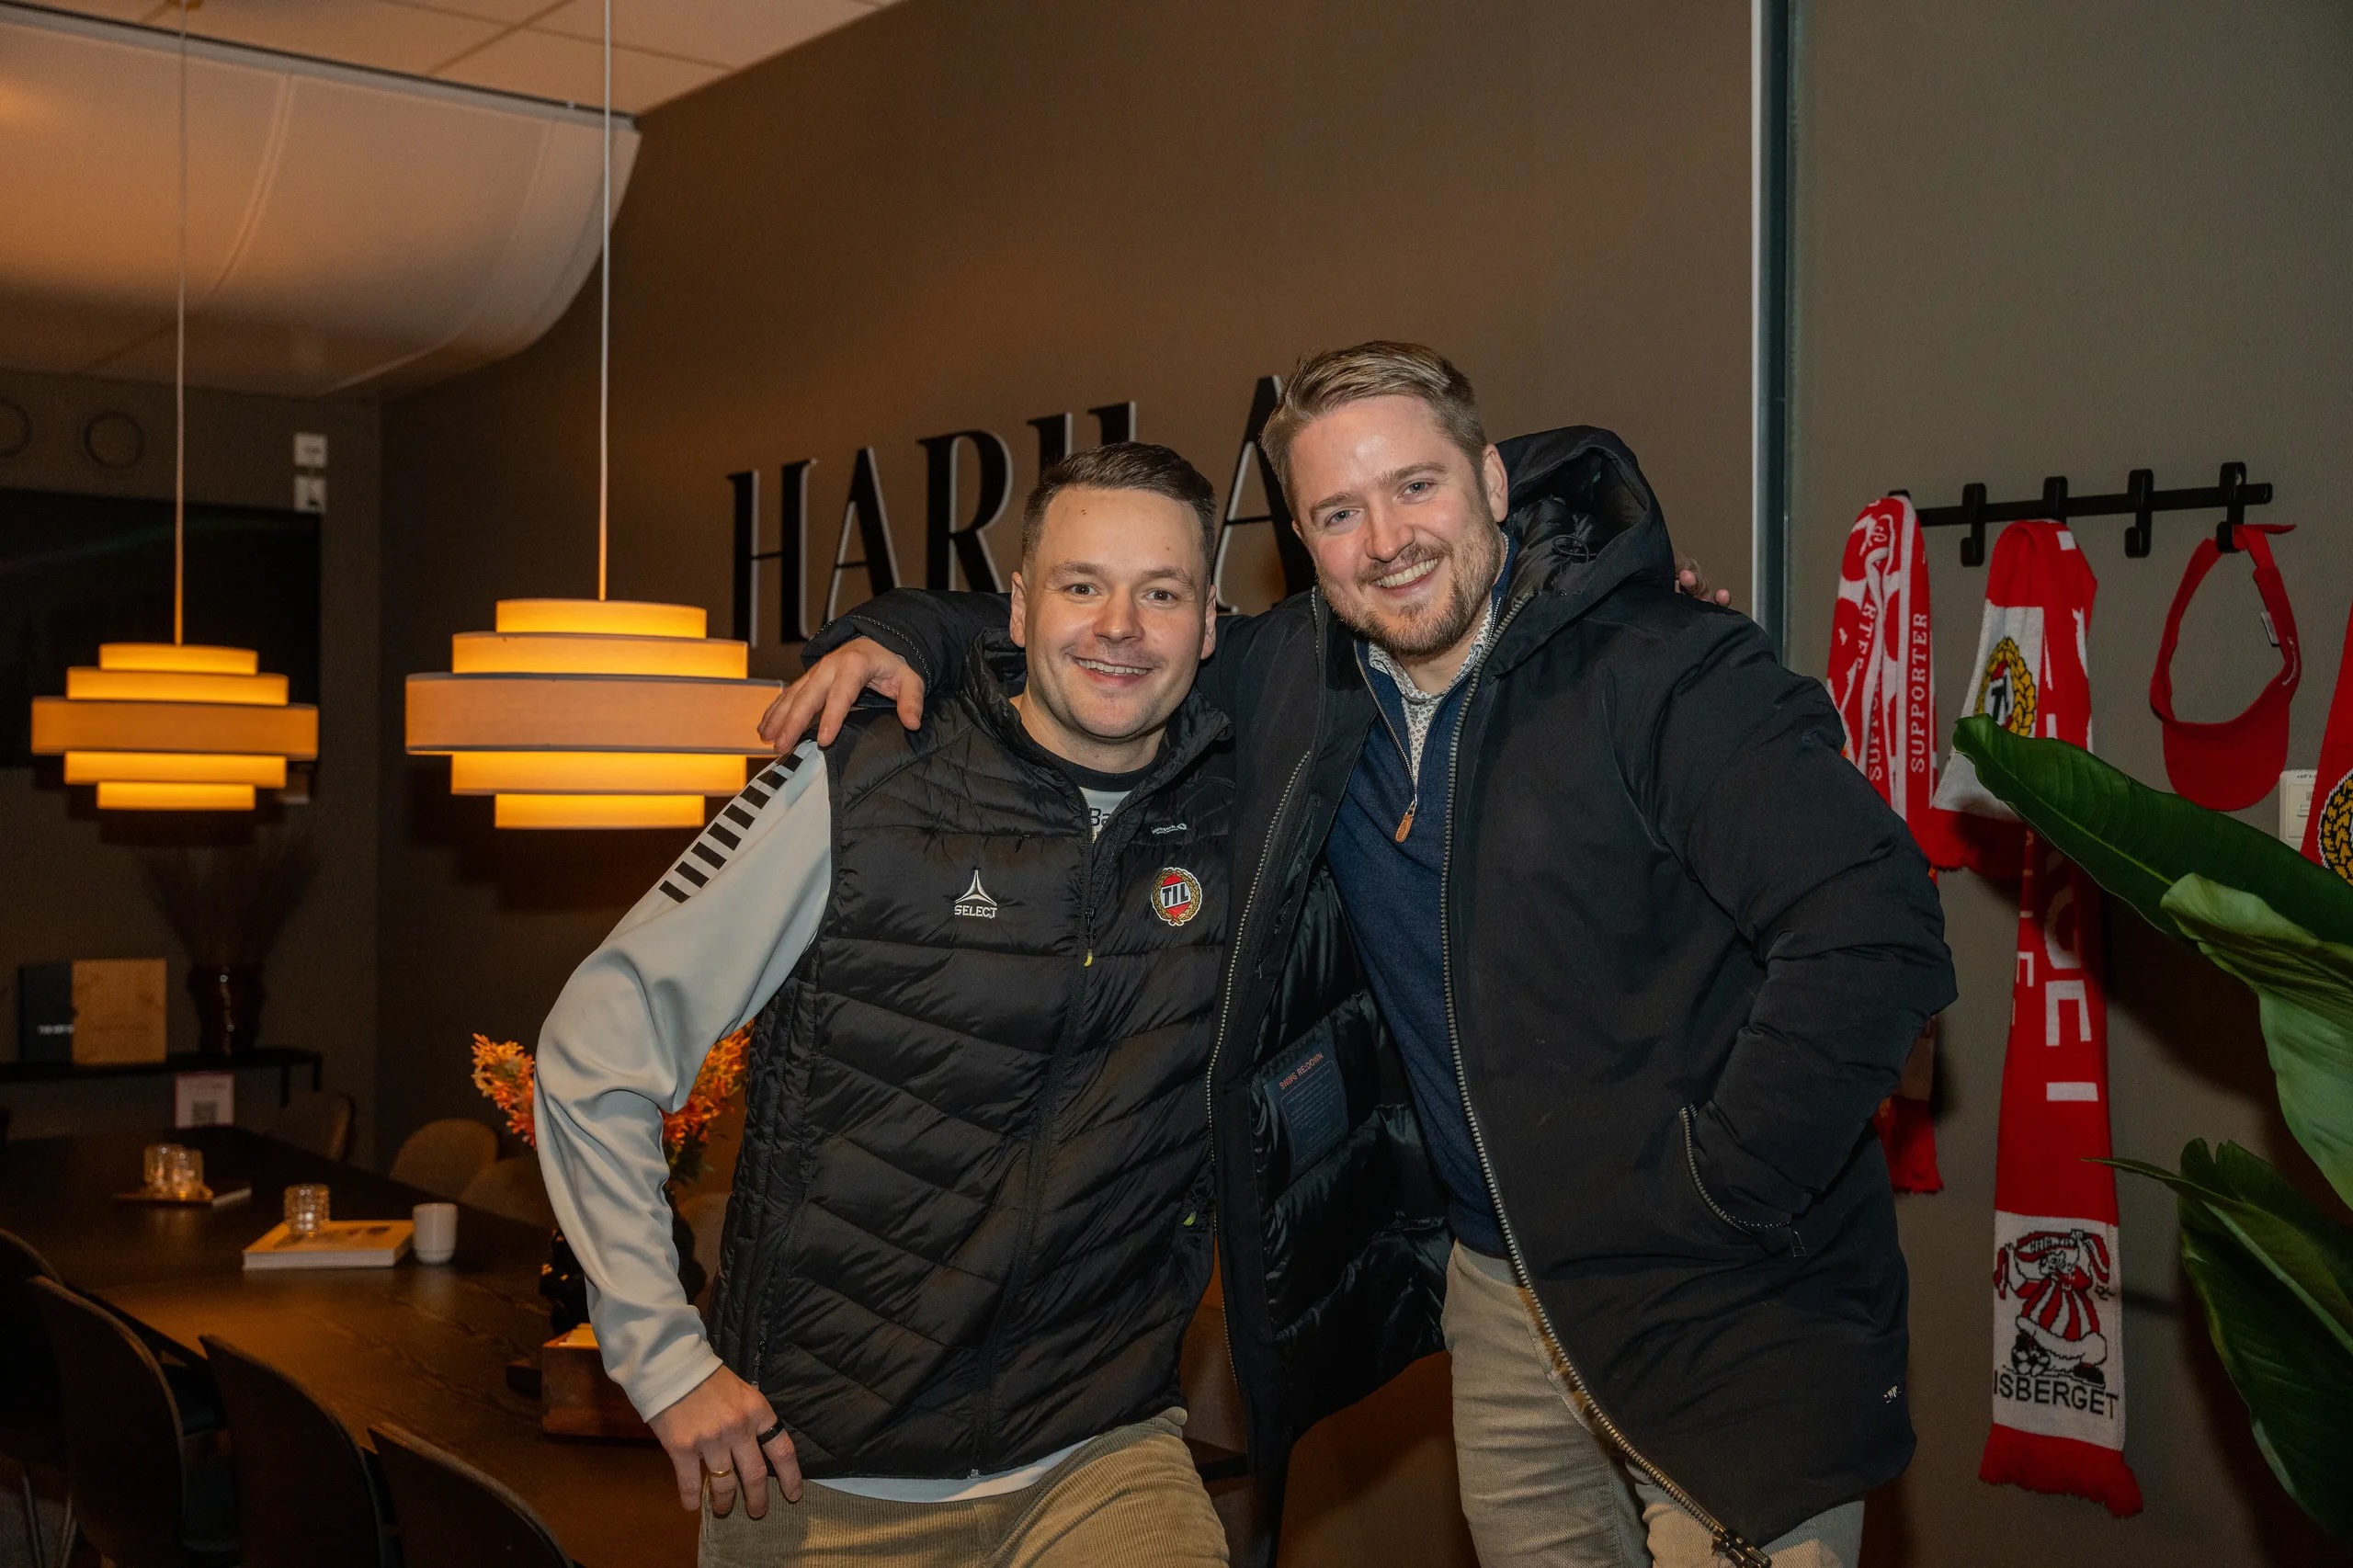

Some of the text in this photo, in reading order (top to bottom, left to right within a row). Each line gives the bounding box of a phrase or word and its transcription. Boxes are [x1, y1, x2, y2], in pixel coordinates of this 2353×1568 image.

[1911, 613, 1928, 774] SUPPORTER
[1162, 882, 1189, 907] TIL
[954, 905, 998, 919] SELECT
[1297, 1052, 1324, 1076] RE:DOWN
[1994, 1370, 2118, 1419] ISBERGET
